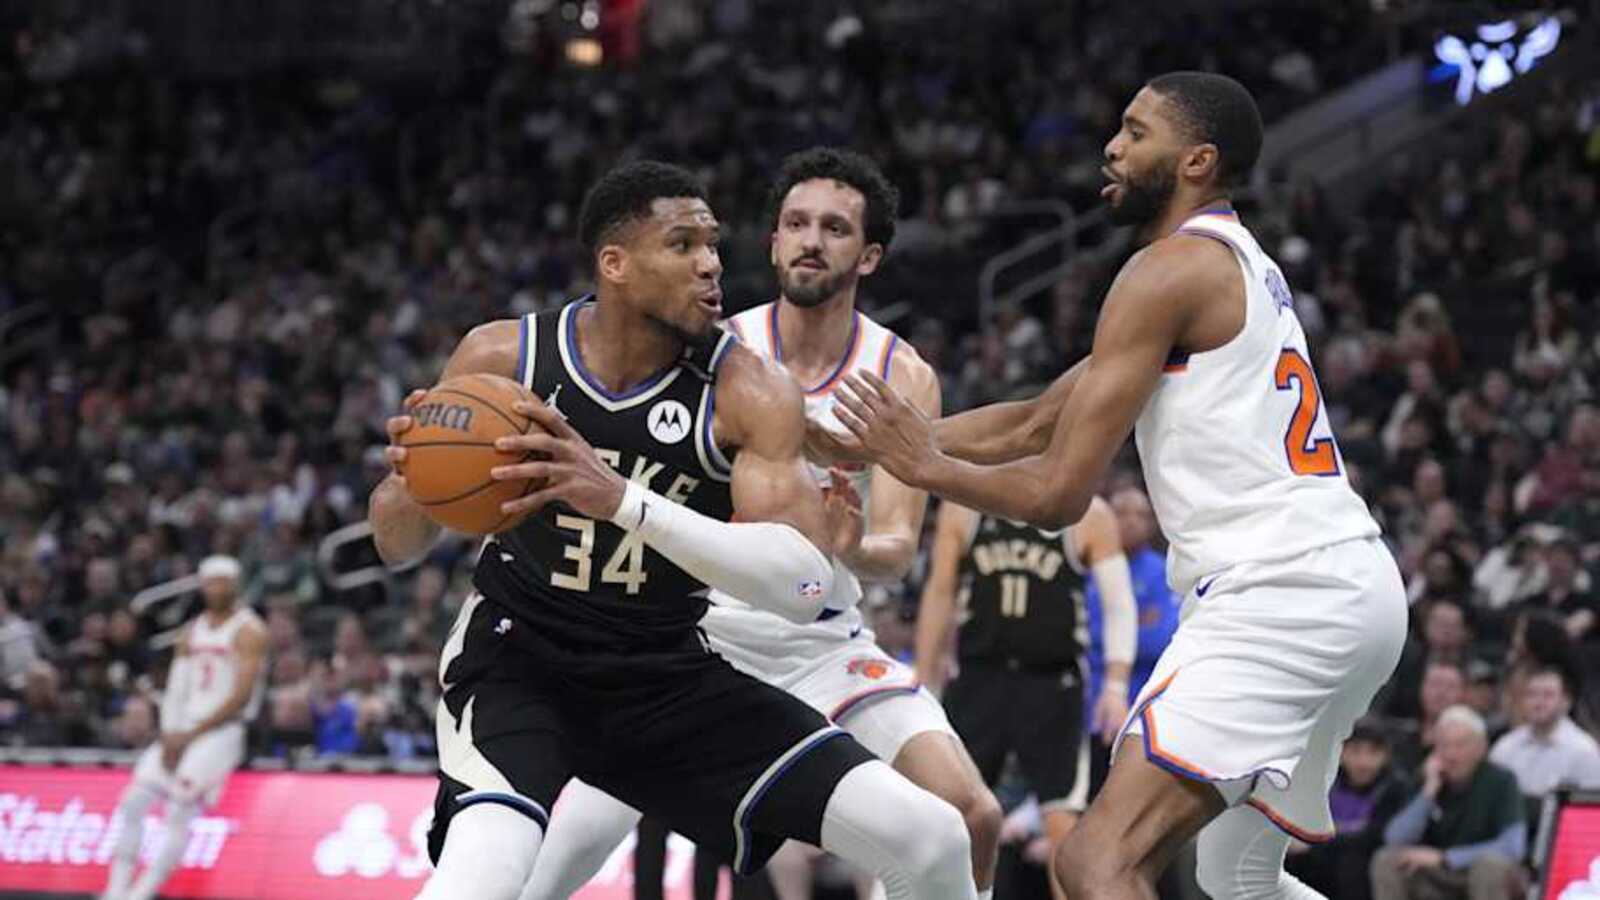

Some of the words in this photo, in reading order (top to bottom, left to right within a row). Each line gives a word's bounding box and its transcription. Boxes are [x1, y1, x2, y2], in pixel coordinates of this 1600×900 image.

[1274, 347, 1341, 476] 2
[551, 513, 648, 595] 34
[973, 540, 1063, 580] BUCKS
[1001, 573, 1028, 618] 11
